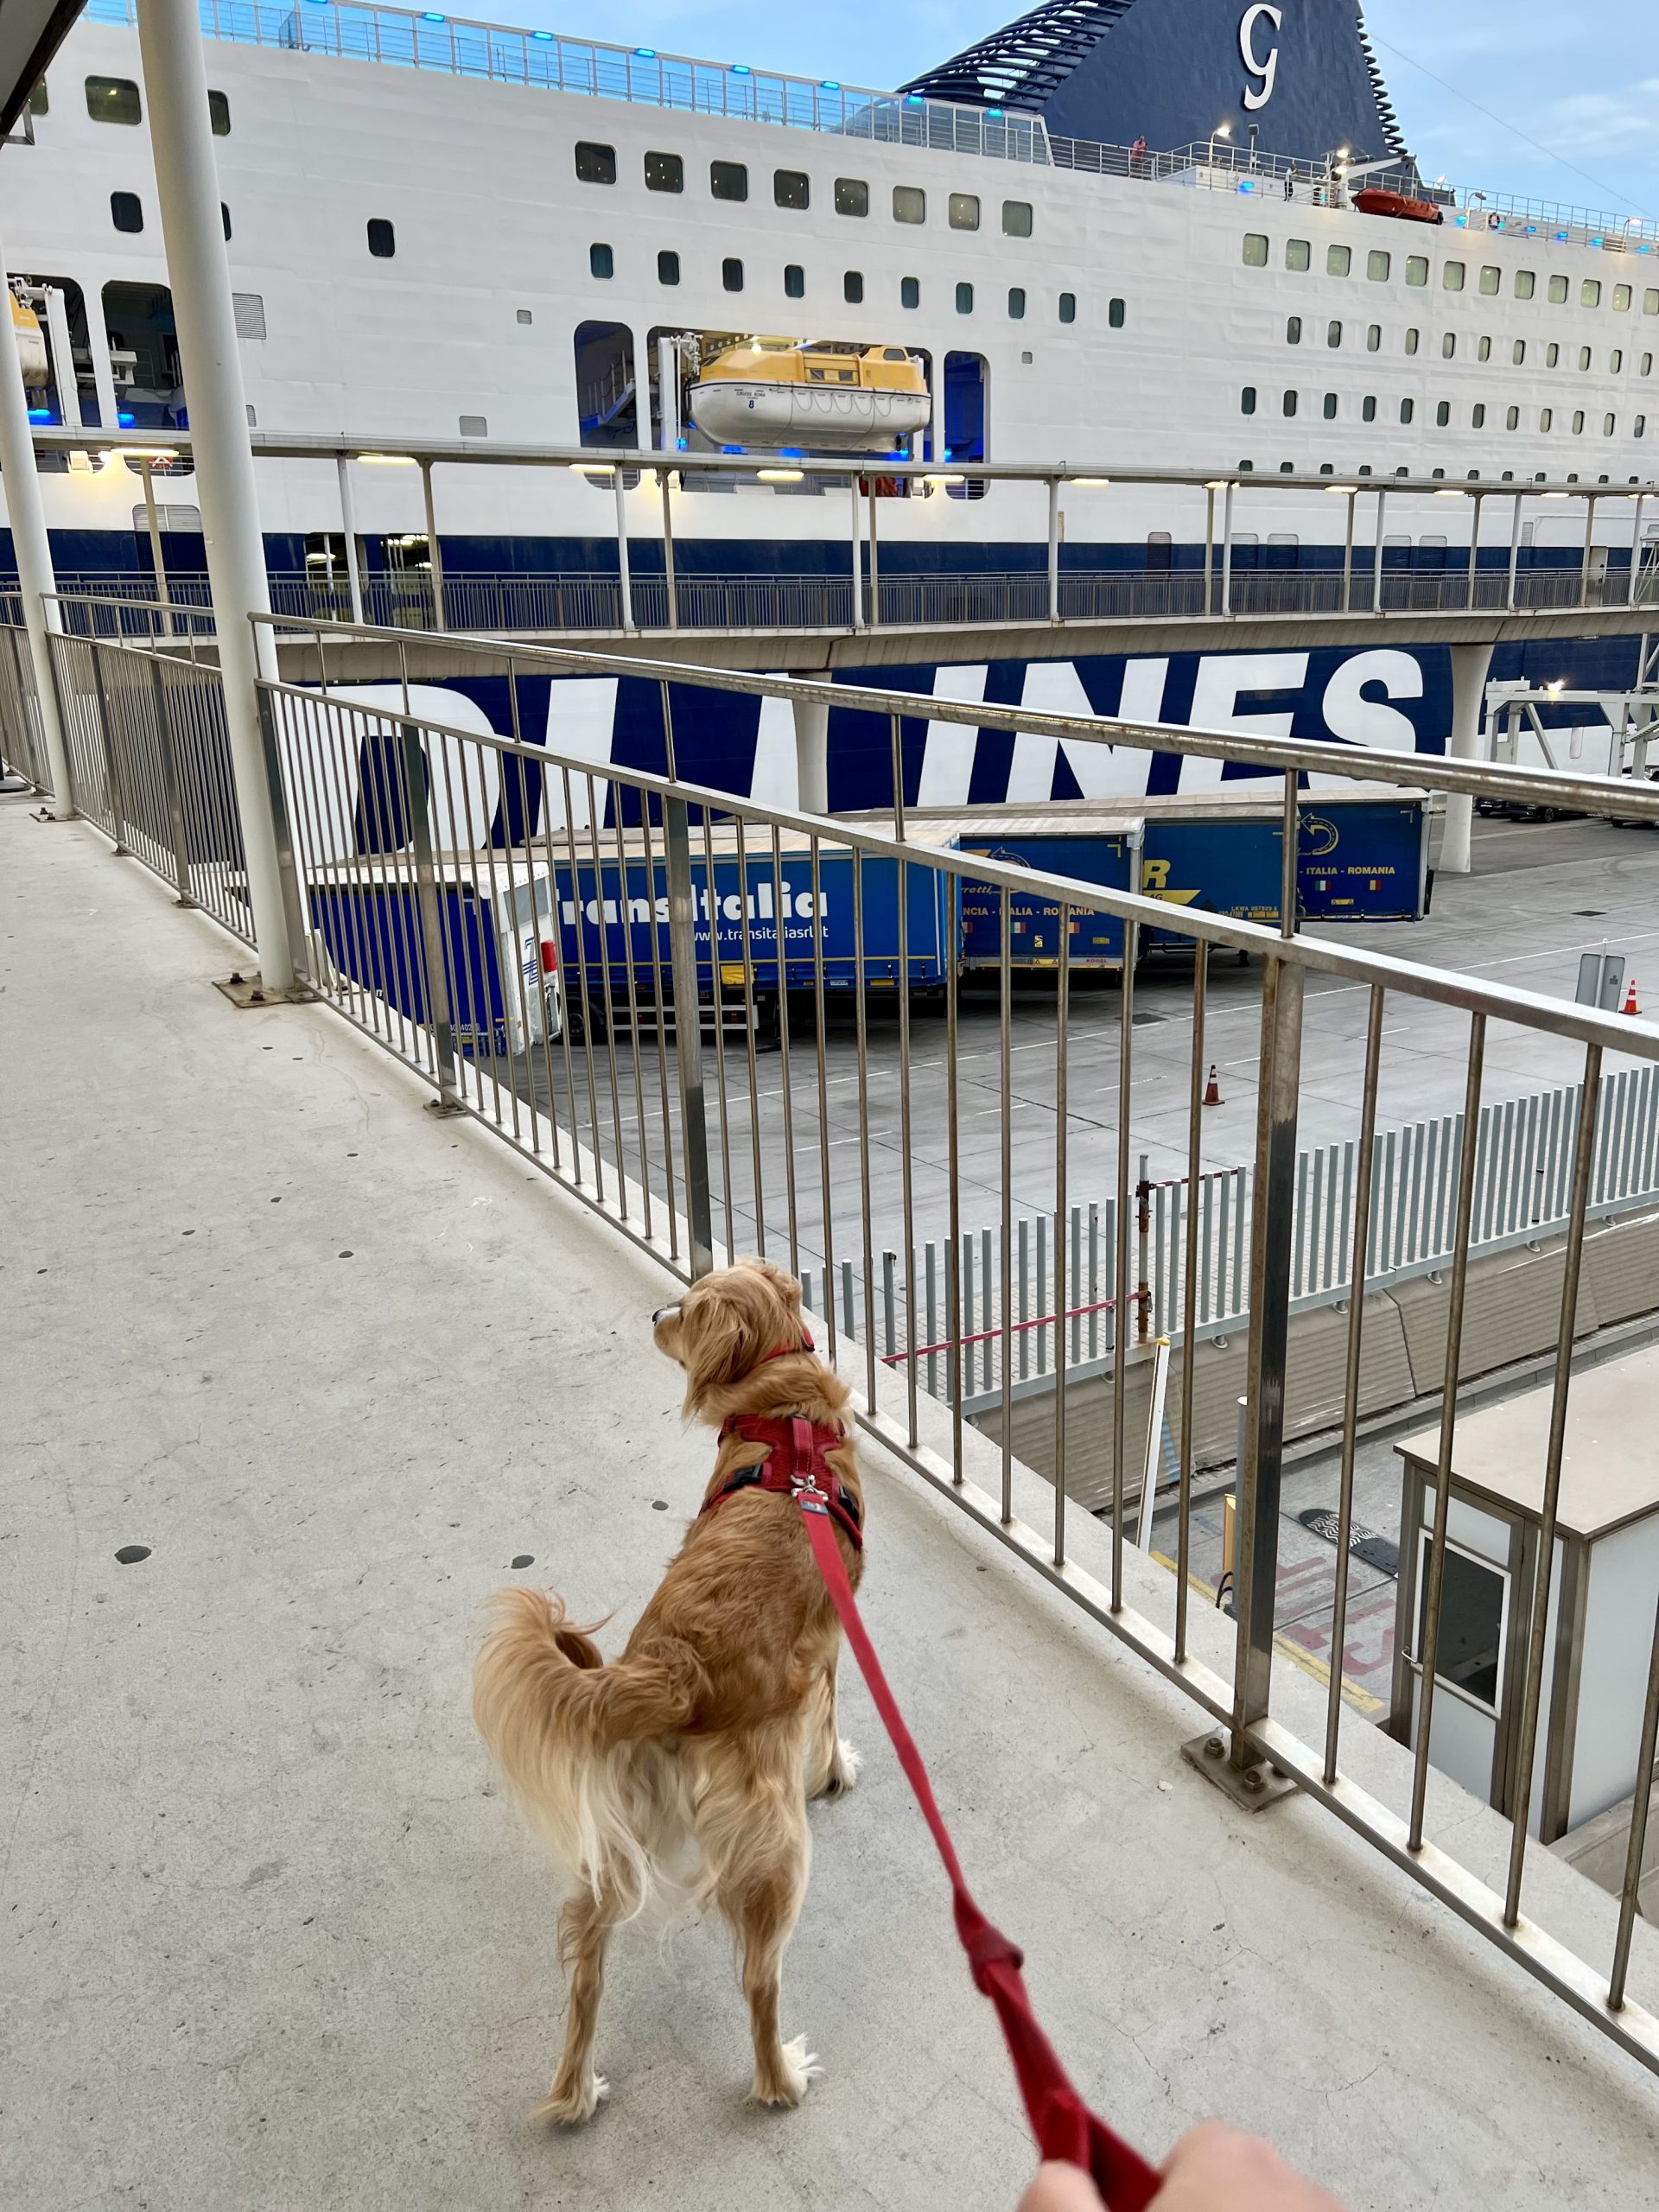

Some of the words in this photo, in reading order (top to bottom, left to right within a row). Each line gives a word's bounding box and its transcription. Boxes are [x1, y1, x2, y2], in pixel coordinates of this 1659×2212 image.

[748, 400, 754, 409] 8
[1306, 867, 1338, 875] ITALIA
[999, 907, 1033, 916] IALIA
[1043, 907, 1096, 916] ROANIA
